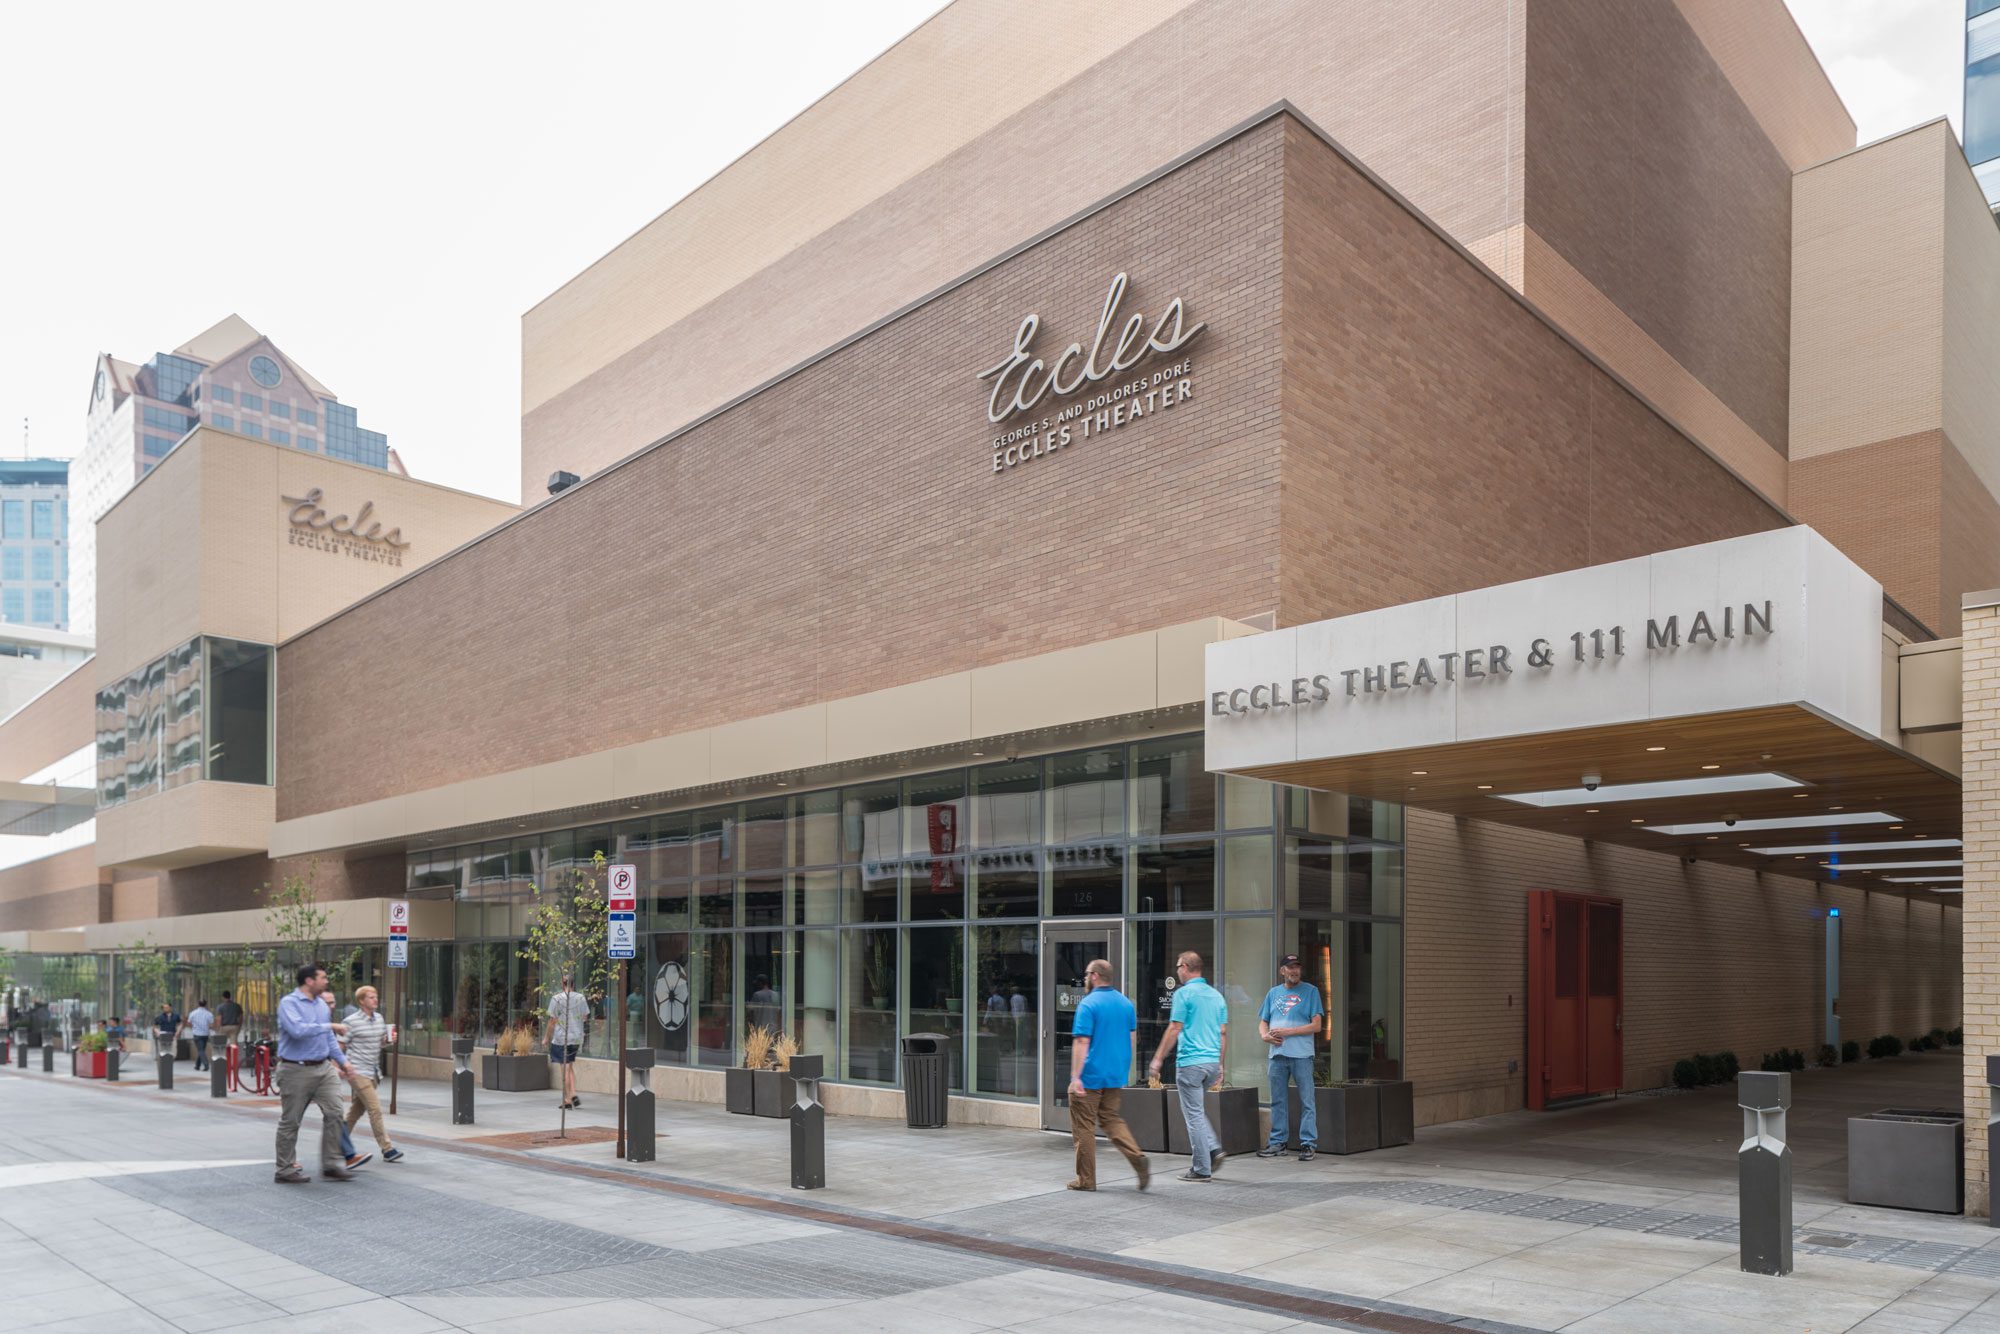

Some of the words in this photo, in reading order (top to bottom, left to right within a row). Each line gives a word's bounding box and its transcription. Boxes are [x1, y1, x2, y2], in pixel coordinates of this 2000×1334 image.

[976, 272, 1208, 423] Eccles
[993, 422, 1039, 449] GEORGE
[1042, 417, 1053, 430] S.
[1057, 405, 1083, 423] AND
[1087, 378, 1149, 412] DOLORES
[1153, 357, 1192, 385] DORÉ
[993, 425, 1072, 473] ECCLES
[1081, 378, 1193, 438] THEATER
[281, 487, 411, 548] Eccles
[288, 534, 339, 554] ECCLES
[344, 546, 402, 567] THEATER
[1211, 674, 1331, 716] ECCLES
[1340, 644, 1513, 697] THEATER
[1527, 638, 1554, 667] &
[1570, 625, 1625, 662] 111
[1646, 600, 1774, 650] MAIN
[1074, 892, 1092, 904] 126
